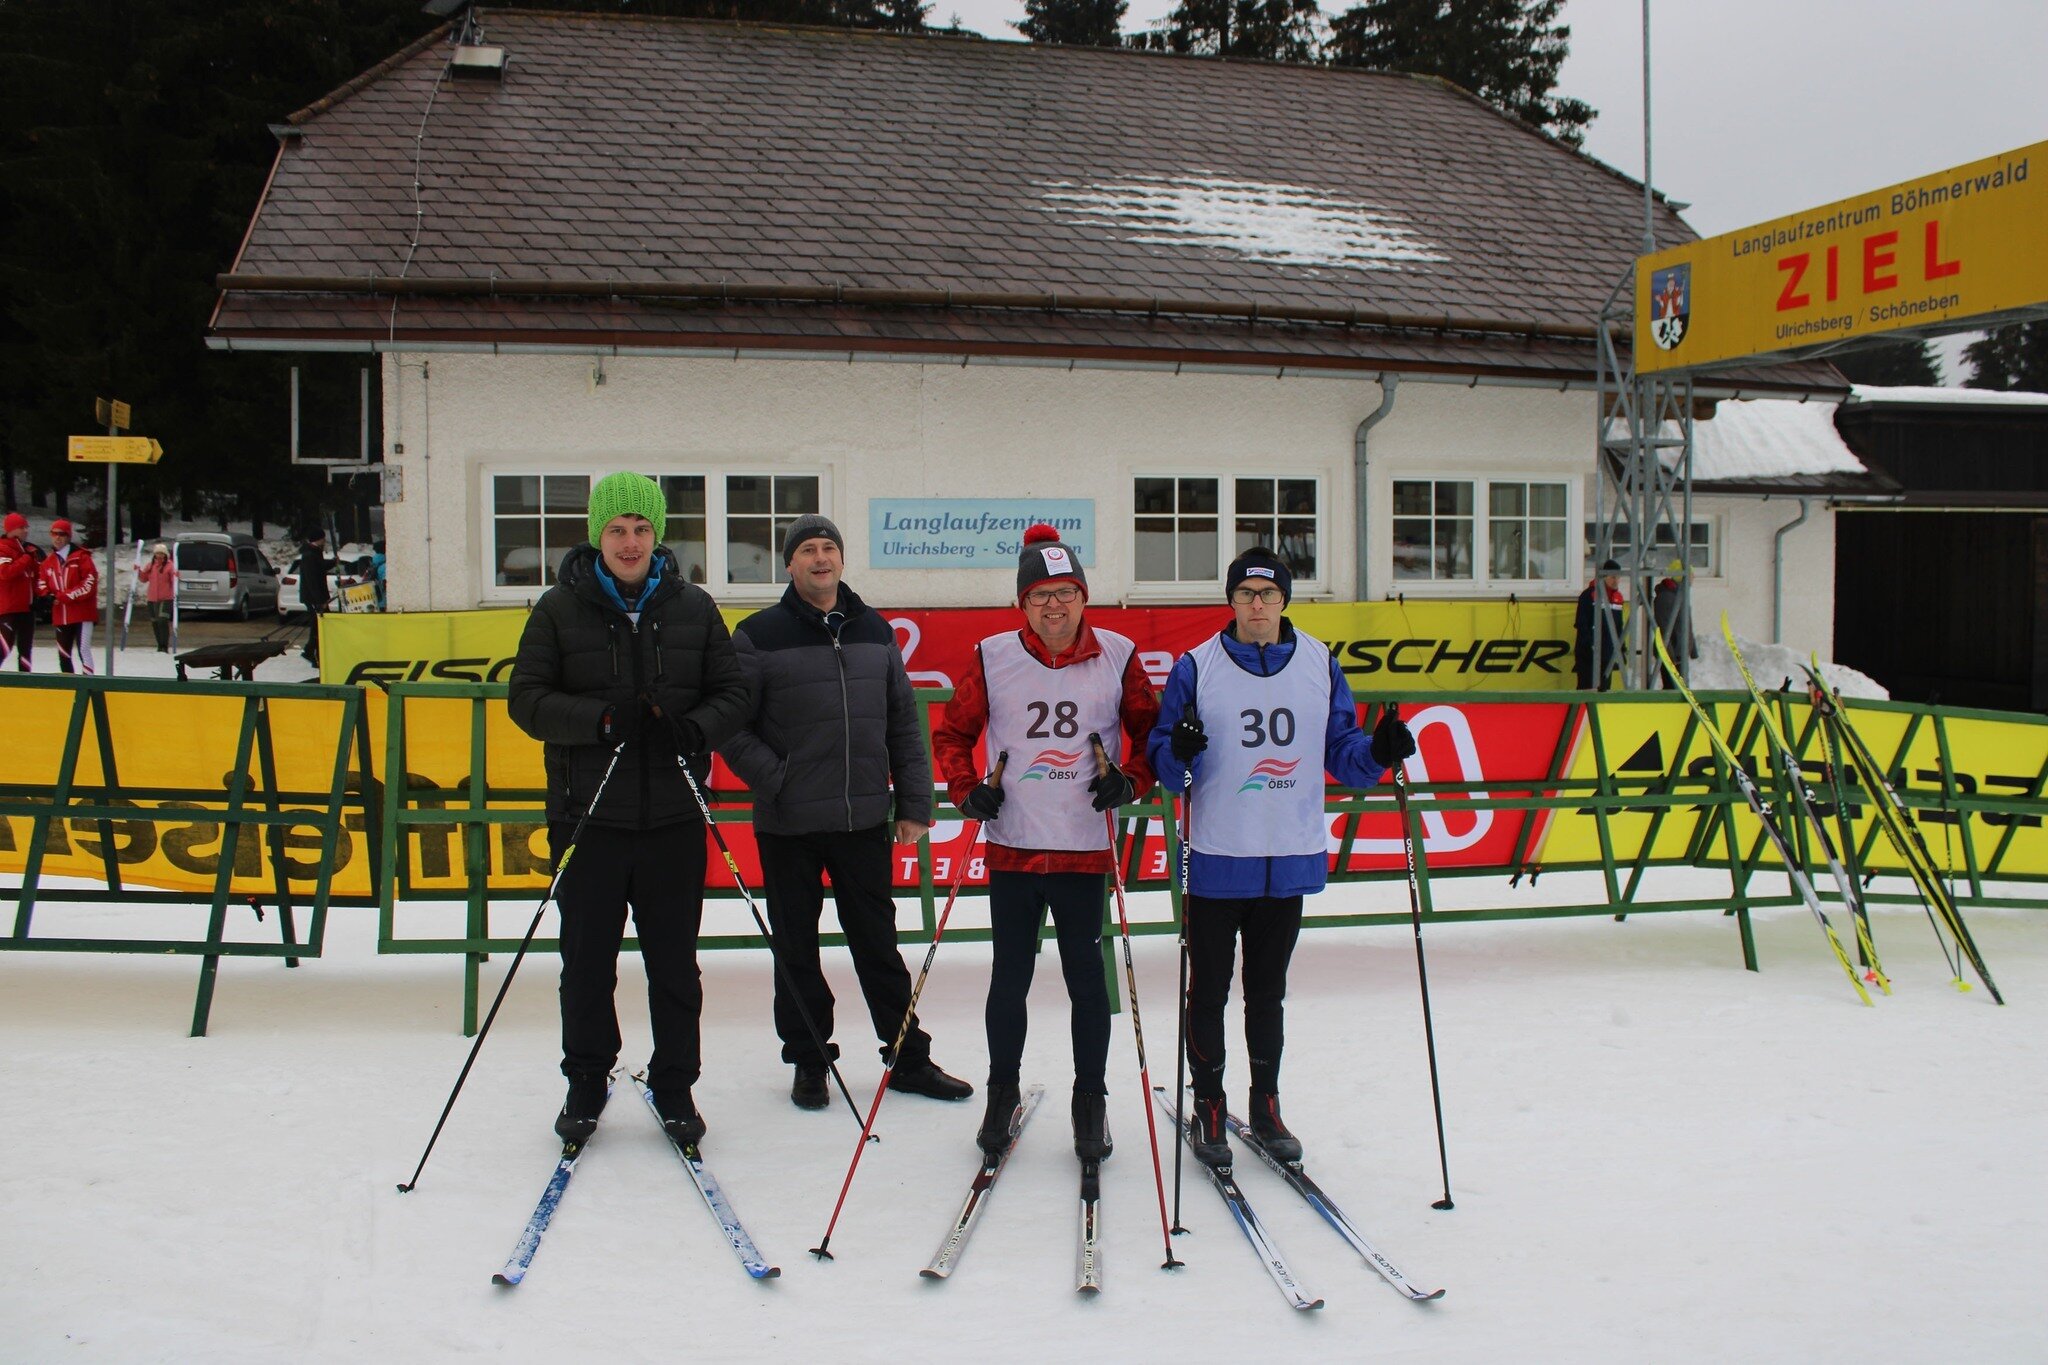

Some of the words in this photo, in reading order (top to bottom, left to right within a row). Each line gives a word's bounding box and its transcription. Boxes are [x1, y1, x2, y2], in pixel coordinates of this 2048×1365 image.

[1733, 204, 1881, 258] Langlaufzentrum
[1891, 158, 2029, 216] Böhmerwald
[1775, 219, 1961, 312] ZIEL
[1776, 312, 1854, 341] Ulrichsberg
[1869, 293, 1960, 324] Schöneben
[883, 541, 976, 558] Ulrichsberg
[1322, 639, 1571, 674] SCHER
[1026, 700, 1079, 739] 28
[1239, 707, 1296, 748] 30
[1048, 768, 1079, 781] ÖBSV
[1267, 778, 1297, 790] ÖBSV
[683, 768, 716, 825] FISCHER
